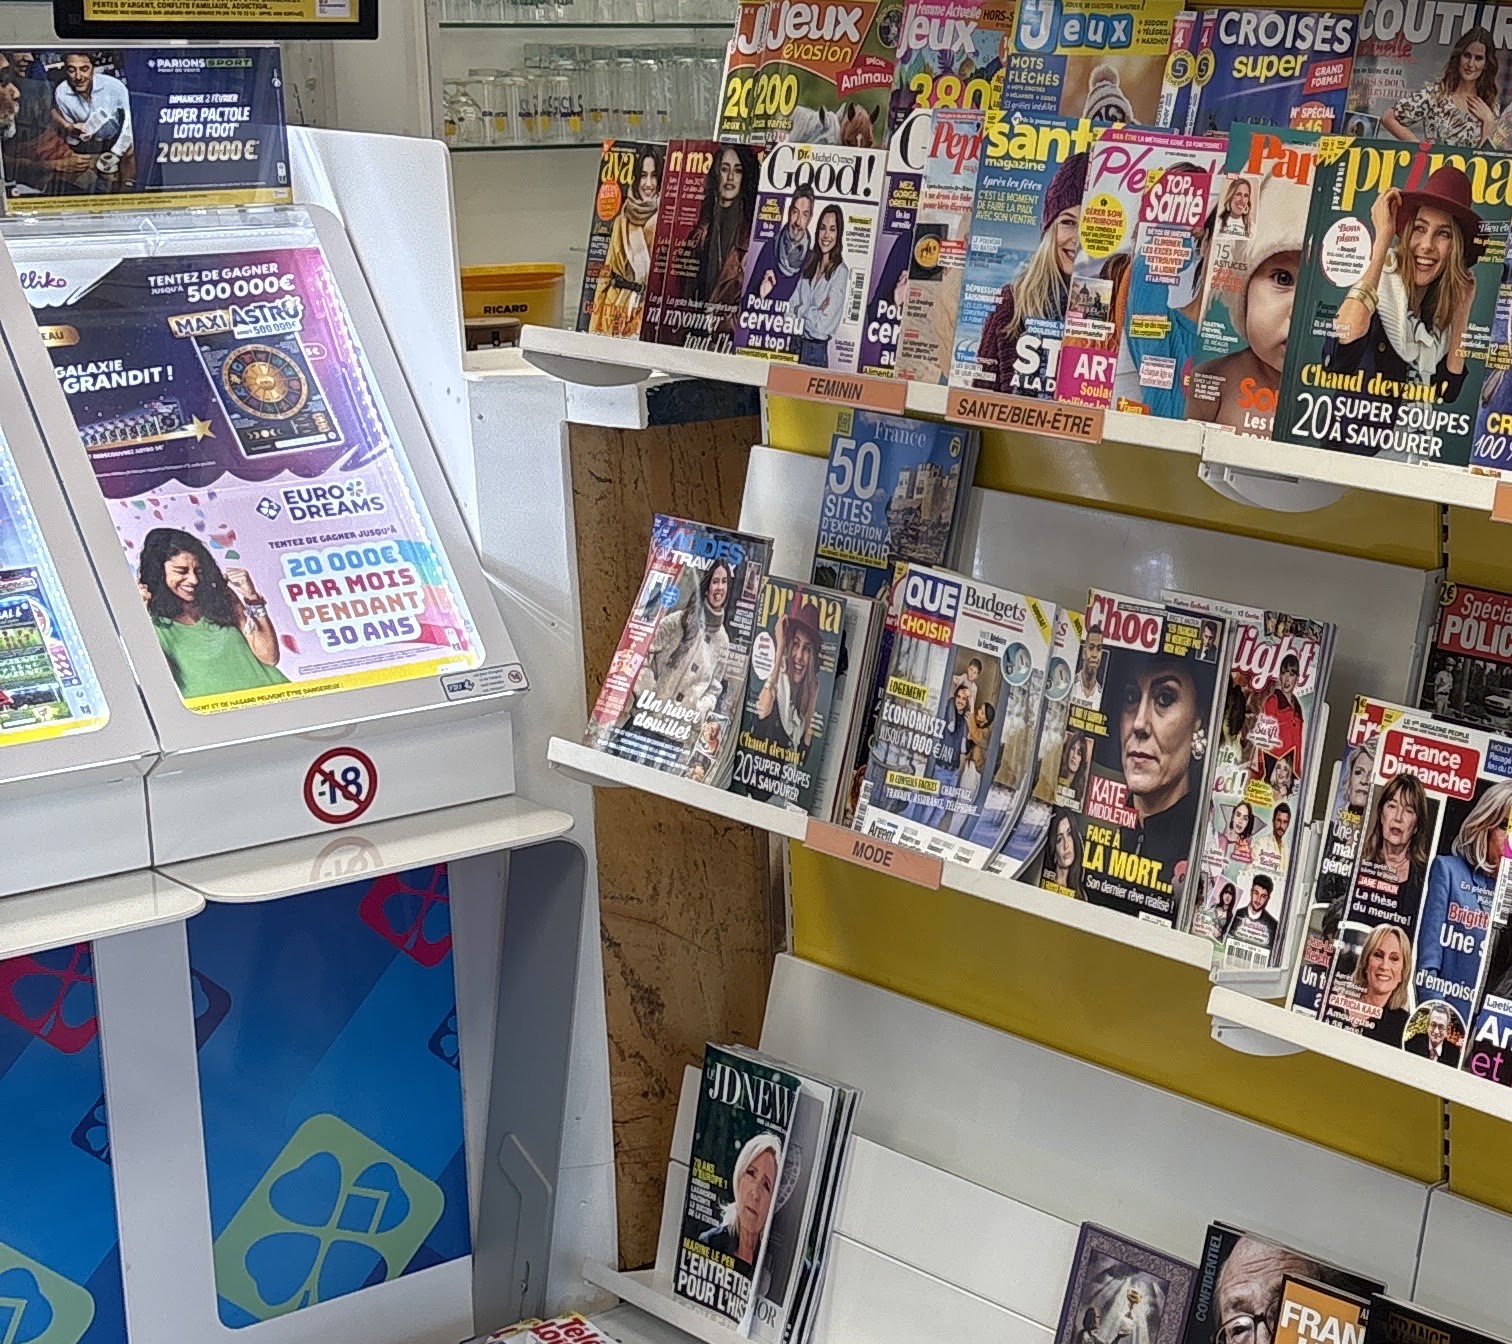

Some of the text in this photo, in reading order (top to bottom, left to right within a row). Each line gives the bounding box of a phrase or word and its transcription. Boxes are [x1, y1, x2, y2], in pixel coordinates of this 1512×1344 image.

[1219, 10, 1353, 55] CROISÉS
[782, 38, 854, 63] évasion
[1010, 56, 1044, 70] MOTS
[1232, 51, 1307, 79] super
[1008, 70, 1060, 85] FLÉCHÉS
[1314, 64, 1344, 78] GRAND
[755, 74, 798, 118] 200
[159, 107, 250, 122] SUPER PACTOLE
[985, 158, 1045, 172] magazine
[1166, 174, 1192, 194] TOP
[1145, 187, 1203, 224] Santé
[148, 263, 279, 287] TENTEZ DE GAGNER
[188, 274, 296, 303] 500 000€
[483, 303, 529, 315] RICARD
[807, 376, 863, 401] FEMININ
[957, 398, 1094, 435] SANTE/BIEN-ÊTRE
[1335, 398, 1470, 436] SUPER SOUPES
[1343, 424, 1443, 457] SAVOURER
[828, 439, 881, 501] 50
[283, 484, 344, 505] EURO
[289, 497, 384, 521] DREAMS
[824, 495, 873, 524] SITES
[286, 568, 416, 602] PAR MOIS
[907, 578, 958, 616] QUE
[298, 591, 418, 625] PENDANT
[963, 584, 1027, 622] Budgets
[322, 617, 415, 647] 30 ANS
[900, 615, 952, 644] CHOISIR
[1399, 736, 1461, 769] France
[851, 841, 893, 867] MODE
